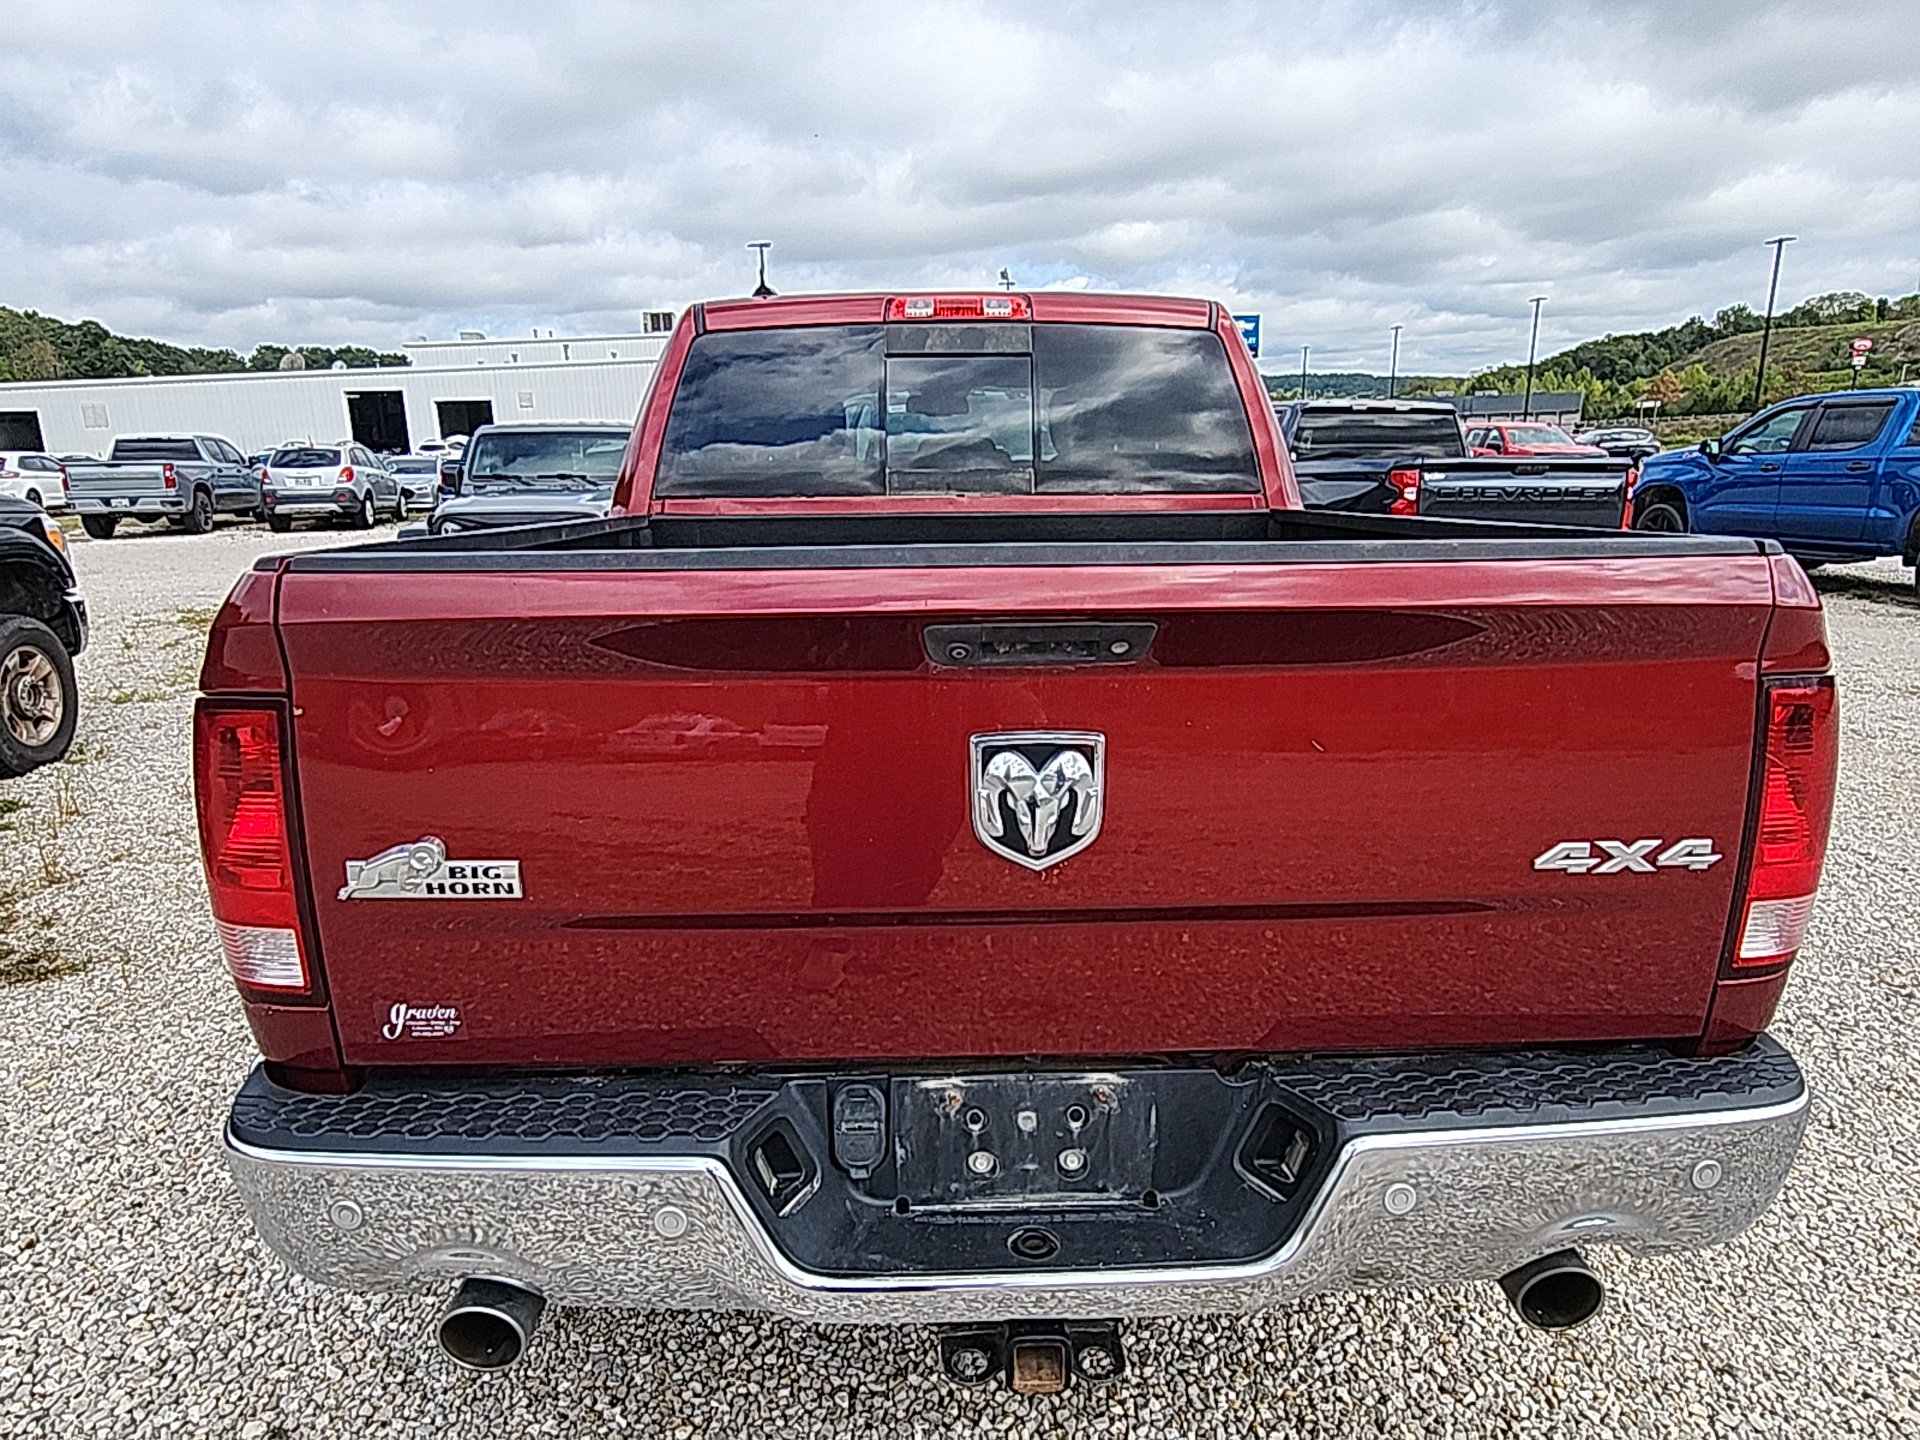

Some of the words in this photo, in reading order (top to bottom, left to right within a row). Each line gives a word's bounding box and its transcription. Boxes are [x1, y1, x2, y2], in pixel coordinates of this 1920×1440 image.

[1435, 486, 1616, 501] CHEVROLET
[1533, 838, 1723, 874] 4X4
[448, 866, 502, 879] BIG
[425, 883, 514, 895] HORN
